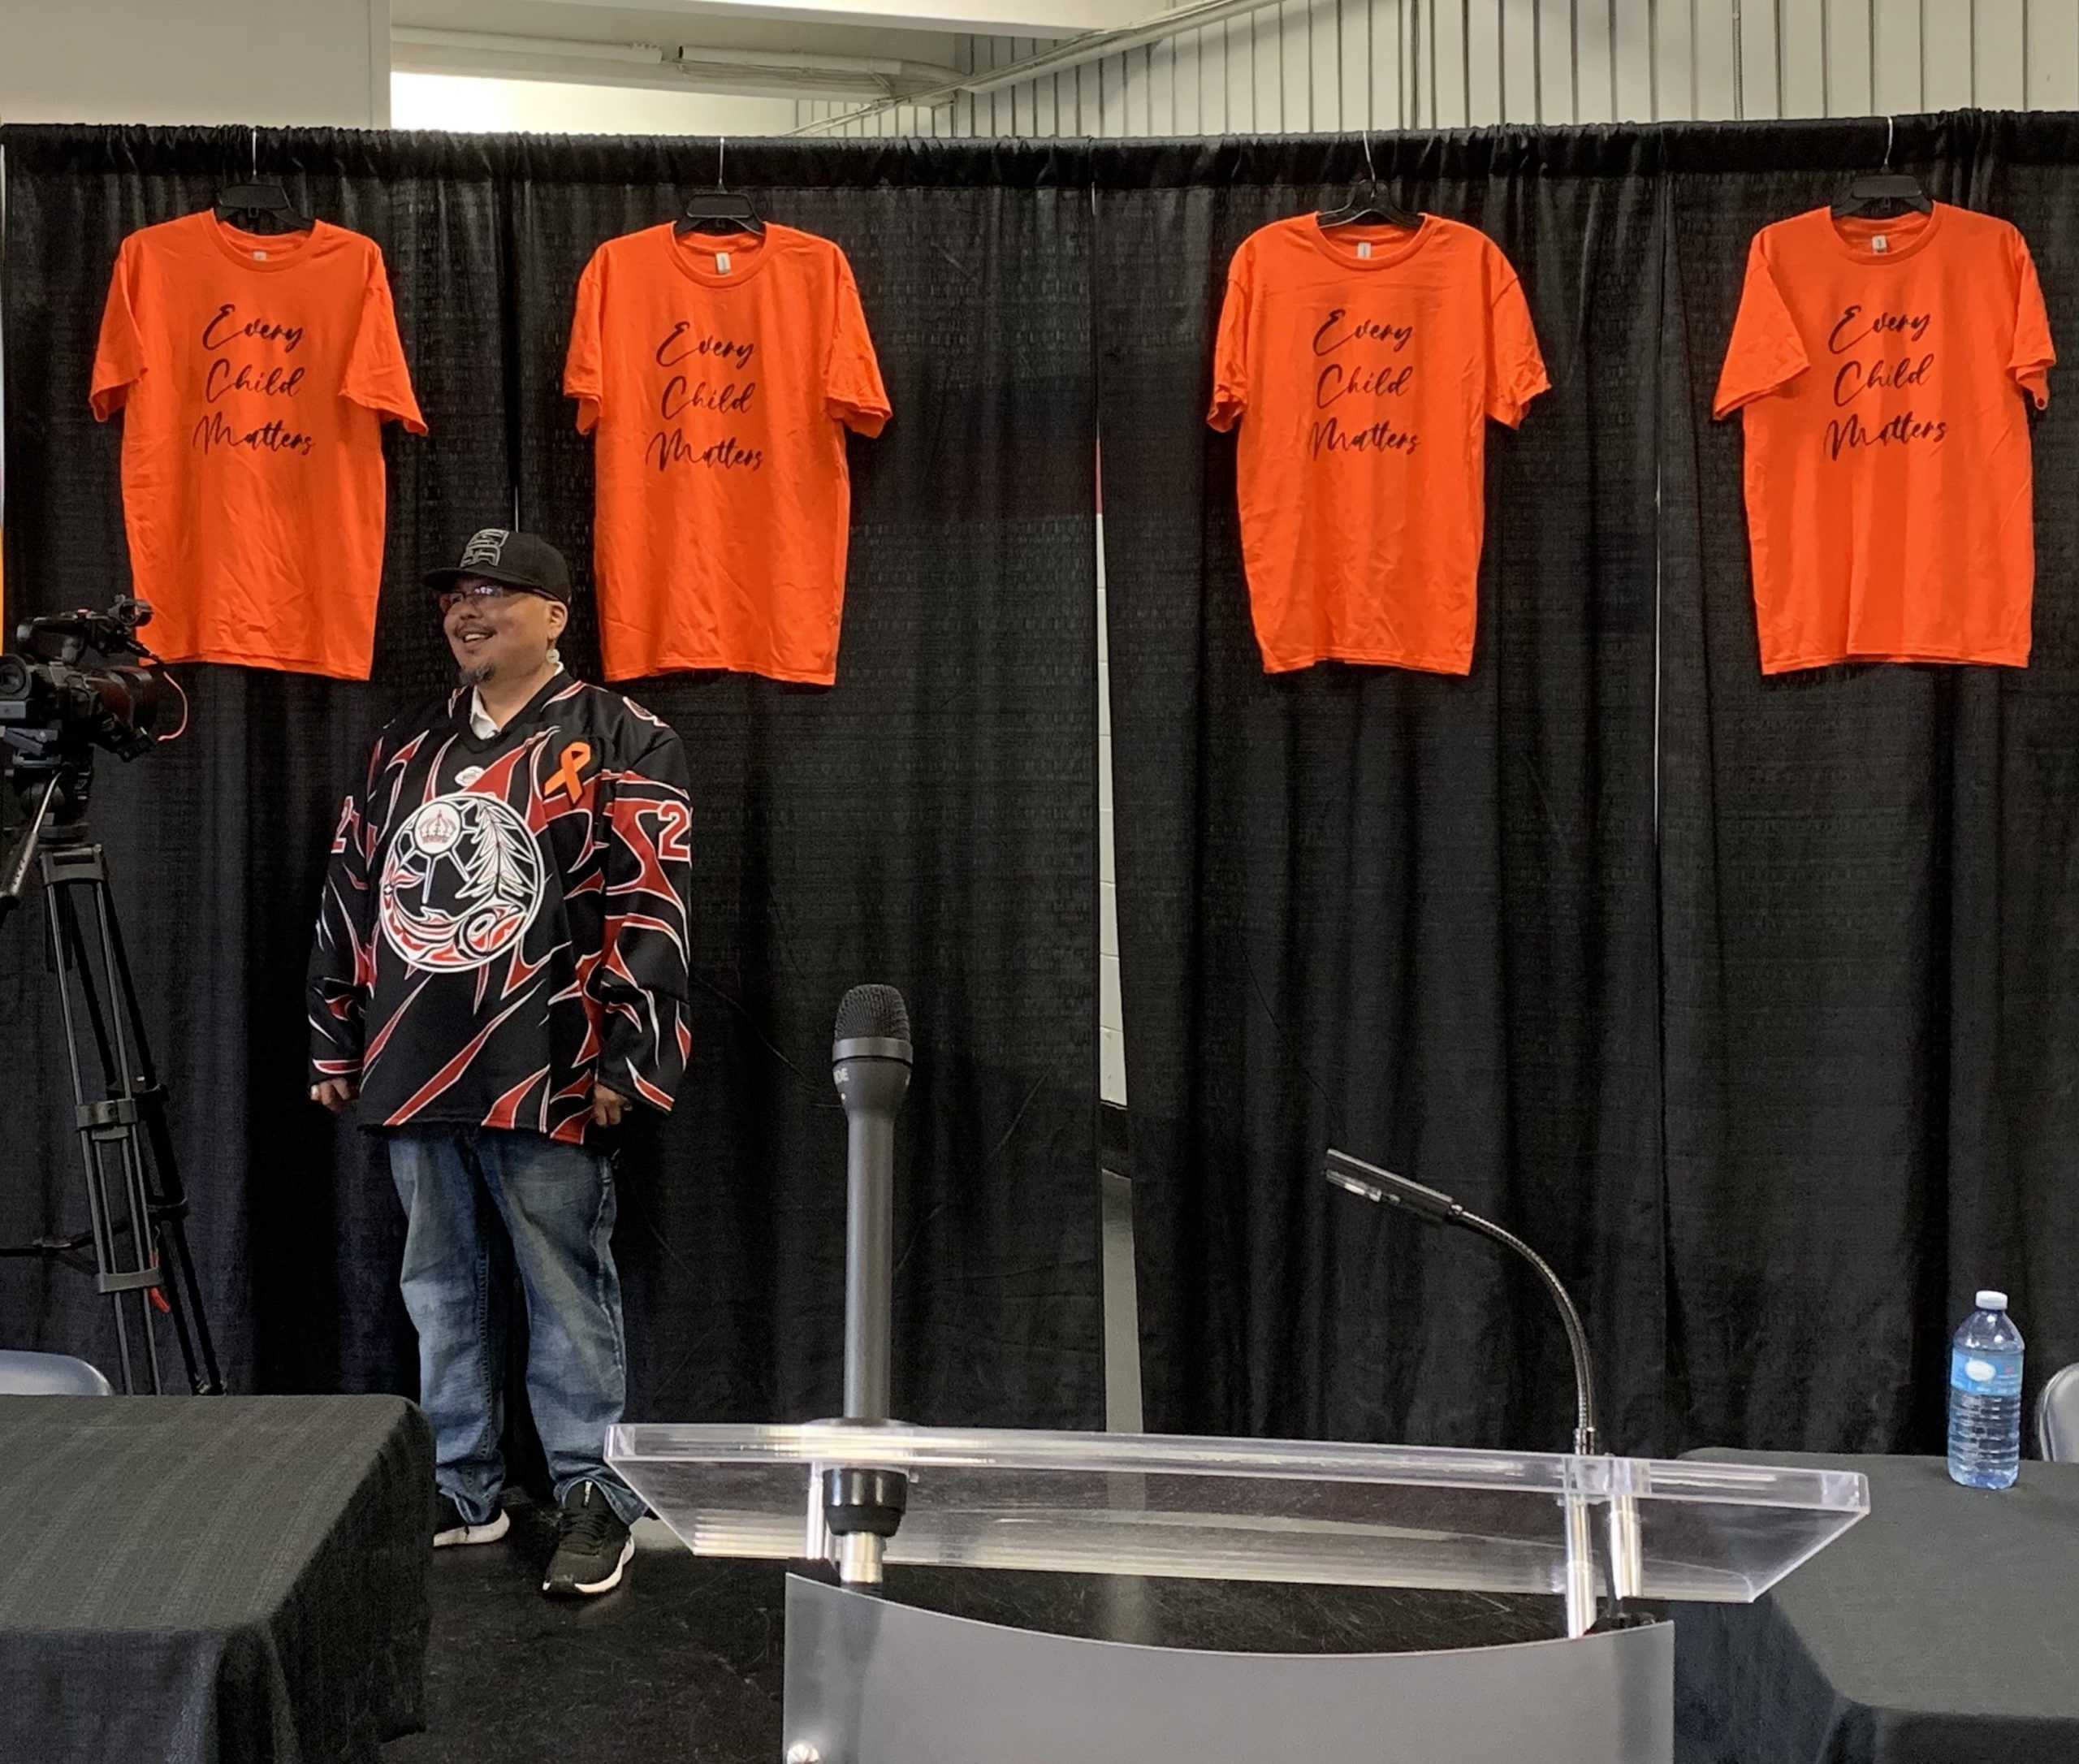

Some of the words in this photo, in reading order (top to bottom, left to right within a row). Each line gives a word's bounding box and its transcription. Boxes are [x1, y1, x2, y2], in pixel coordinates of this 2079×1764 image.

[201, 303, 305, 353] Every
[655, 321, 755, 370] Every
[1312, 309, 1413, 357] Every
[1828, 305, 1931, 355] Every
[205, 357, 306, 404] Child
[660, 375, 756, 421] Child
[1316, 363, 1413, 410] Child
[1833, 352, 1934, 408] Child
[192, 411, 314, 456] Matters
[645, 431, 763, 473] Matters
[1308, 417, 1421, 462] Matters
[1823, 410, 1948, 462] Matters
